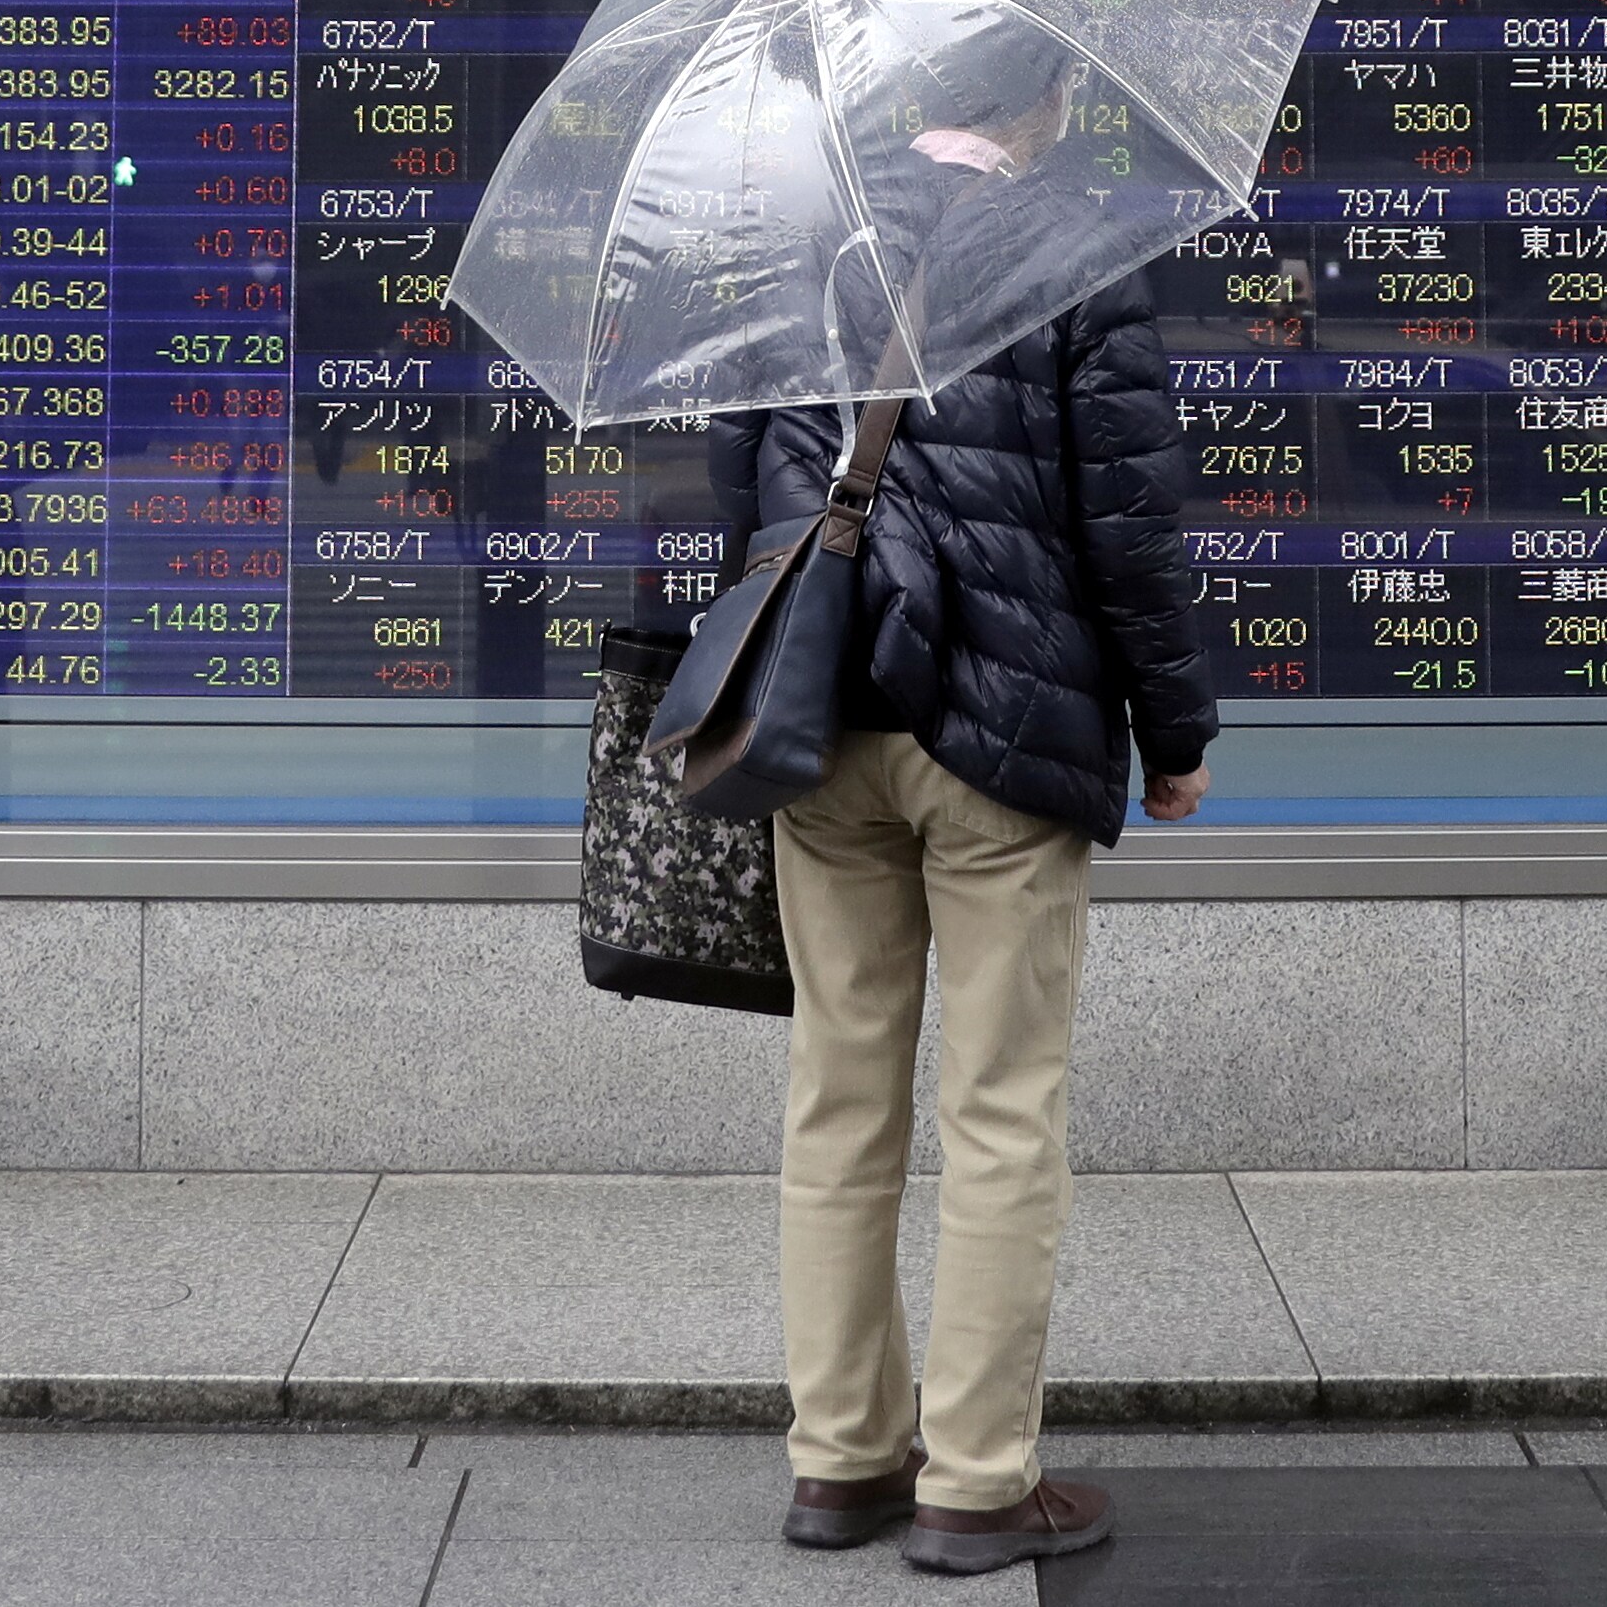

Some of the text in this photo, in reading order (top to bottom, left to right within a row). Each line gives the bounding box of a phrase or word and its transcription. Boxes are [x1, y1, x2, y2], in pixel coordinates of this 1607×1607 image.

[176, 15, 292, 48] +89.03
[1334, 16, 1449, 49] 7951/T
[154, 69, 290, 99] 3282.15
[316, 56, 441, 92] パナソニック
[1343, 58, 1436, 90] ヤマハ
[1394, 103, 1471, 133] 5360
[197, 122, 289, 153] +0.16
[193, 175, 290, 205] +0.60
[320, 186, 434, 219] 6753/T
[1337, 185, 1451, 218] 7974/T
[195, 225, 289, 259] +0.70
[316, 225, 437, 261] シャープ
[1175, 231, 1274, 259] HOYA
[1343, 225, 1447, 260] 任天堂
[190, 282, 284, 312] +1.01
[155, 335, 284, 364] -357.28
[1169, 357, 1283, 389] 7751/T
[172, 388, 284, 419] +0.888
[318, 399, 432, 432] アンリツ
[1174, 397, 1287, 432] キヤノン
[1357, 397, 1434, 431] コクヨ
[167, 442, 286, 472] +86.80
[1398, 444, 1473, 474] 1535
[125, 494, 284, 526] +63.4898
[545, 490, 618, 519] +255
[316, 528, 431, 561] 6758/T
[486, 529, 601, 561] 6902/T
[167, 548, 283, 579] +18.40
[329, 574, 417, 603] ソニー
[483, 569, 603, 604] デンソー
[1347, 568, 1451, 603] 伊藤忠
[131, 602, 281, 632] -1448.37
[1229, 617, 1307, 647] 1020
[5, 655, 101, 685] 44.76
[195, 656, 280, 686] -2.33
